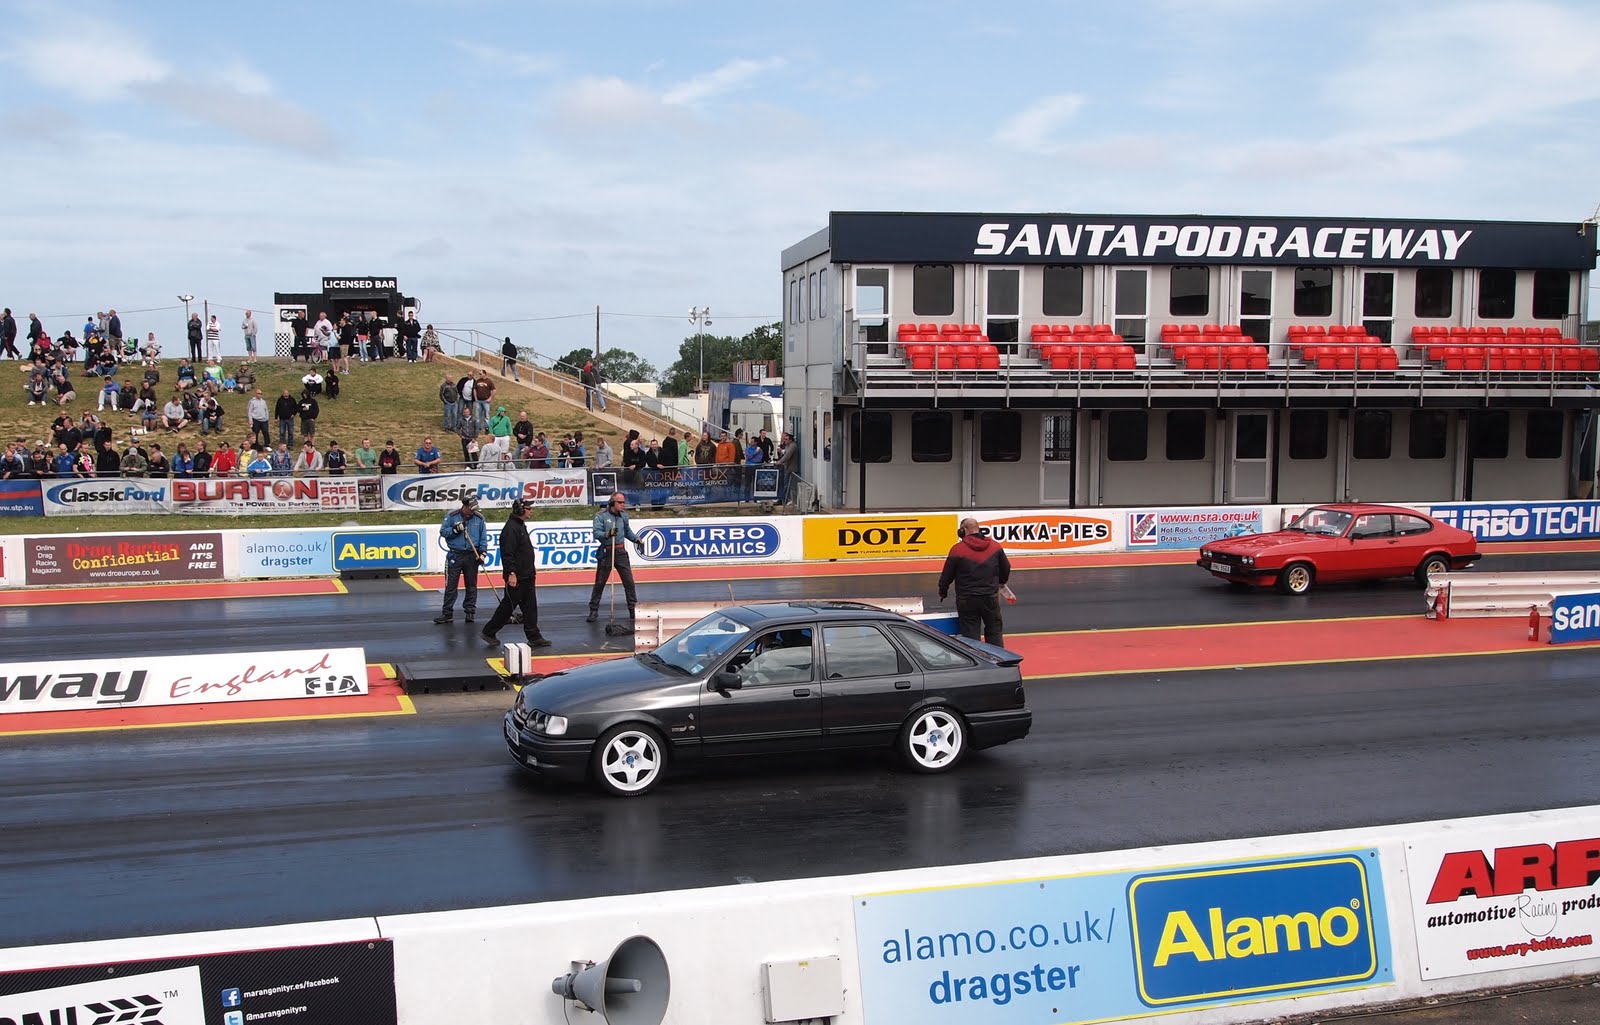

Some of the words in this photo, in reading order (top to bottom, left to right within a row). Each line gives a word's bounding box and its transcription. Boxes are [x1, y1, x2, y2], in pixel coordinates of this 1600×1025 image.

[324, 281, 373, 289] LICENSED
[375, 281, 396, 289] BAR
[645, 470, 693, 481] ADRIAN
[698, 469, 728, 480] FLUX
[172, 480, 318, 501] BURTON
[320, 486, 357, 495] FREE
[321, 495, 357, 506] 2011
[1160, 511, 1258, 523] www.nsra.org.uk
[670, 528, 765, 541] TURBO
[838, 527, 926, 546] DOTZ
[189, 543, 214, 551] AND
[246, 541, 328, 554] alamo.co.uk/
[338, 543, 416, 561] Alamo
[670, 541, 766, 556] DYNAMICS
[37, 552, 53, 560] Drag
[72, 549, 181, 570] Confidential
[191, 552, 213, 560] IT'S
[261, 556, 314, 568] dragster
[35, 559, 58, 567] Racing
[188, 561, 217, 570] FREE
[32, 567, 62, 575] Magazine
[90, 569, 160, 578] www.drceurope.co.uk
[169, 653, 332, 698] England
[1426, 837, 1600, 905] ARP
[1427, 905, 1516, 928] automotive
[1515, 894, 1558, 937] Racing
[882, 907, 1116, 964] alamo.co.uk/
[1466, 934, 1593, 961] www.arp-bolts.com
[243, 976, 340, 998] marangonityr.es/facebook
[929, 962, 1081, 1005] dragster
[163, 989, 179, 999] TM
[246, 1005, 308, 1021] @marangonityre
